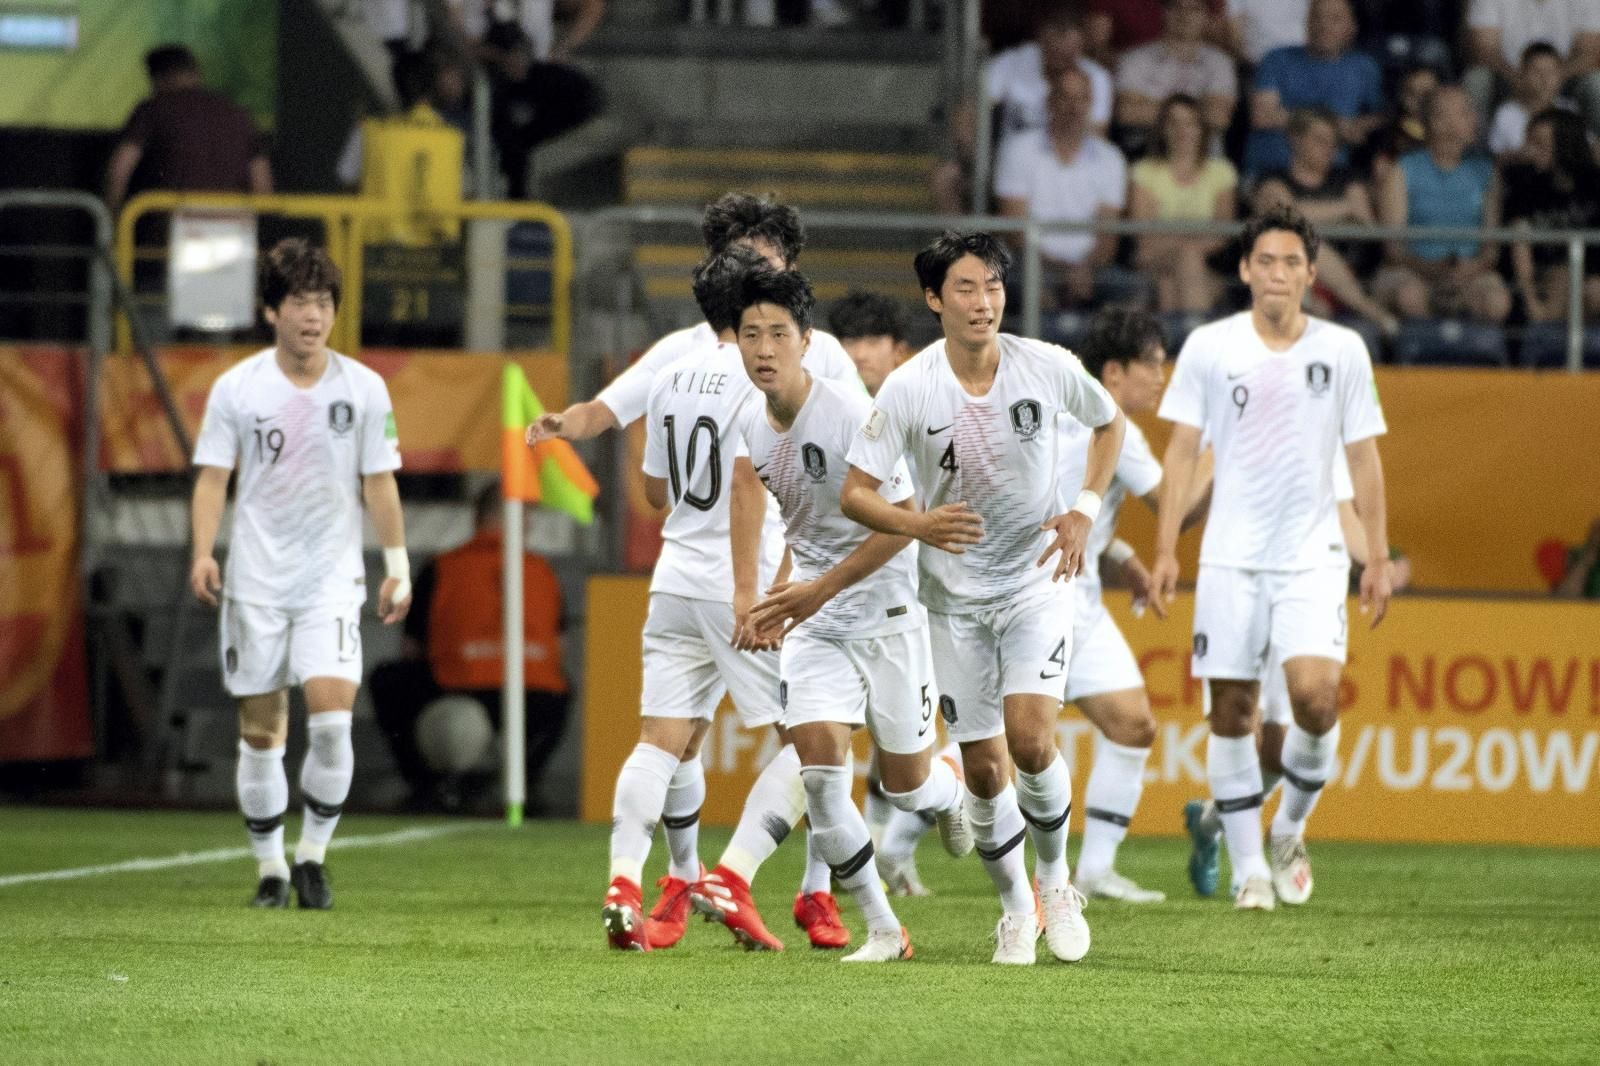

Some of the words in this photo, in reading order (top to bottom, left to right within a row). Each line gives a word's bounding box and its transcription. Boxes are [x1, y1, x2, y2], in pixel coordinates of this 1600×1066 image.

[699, 374, 728, 395] LEE
[1232, 385, 1249, 420] 9
[254, 428, 285, 465] 19
[663, 415, 722, 512] 10
[939, 438, 959, 474] 4
[1048, 636, 1066, 671] 4
[920, 682, 932, 722] 5
